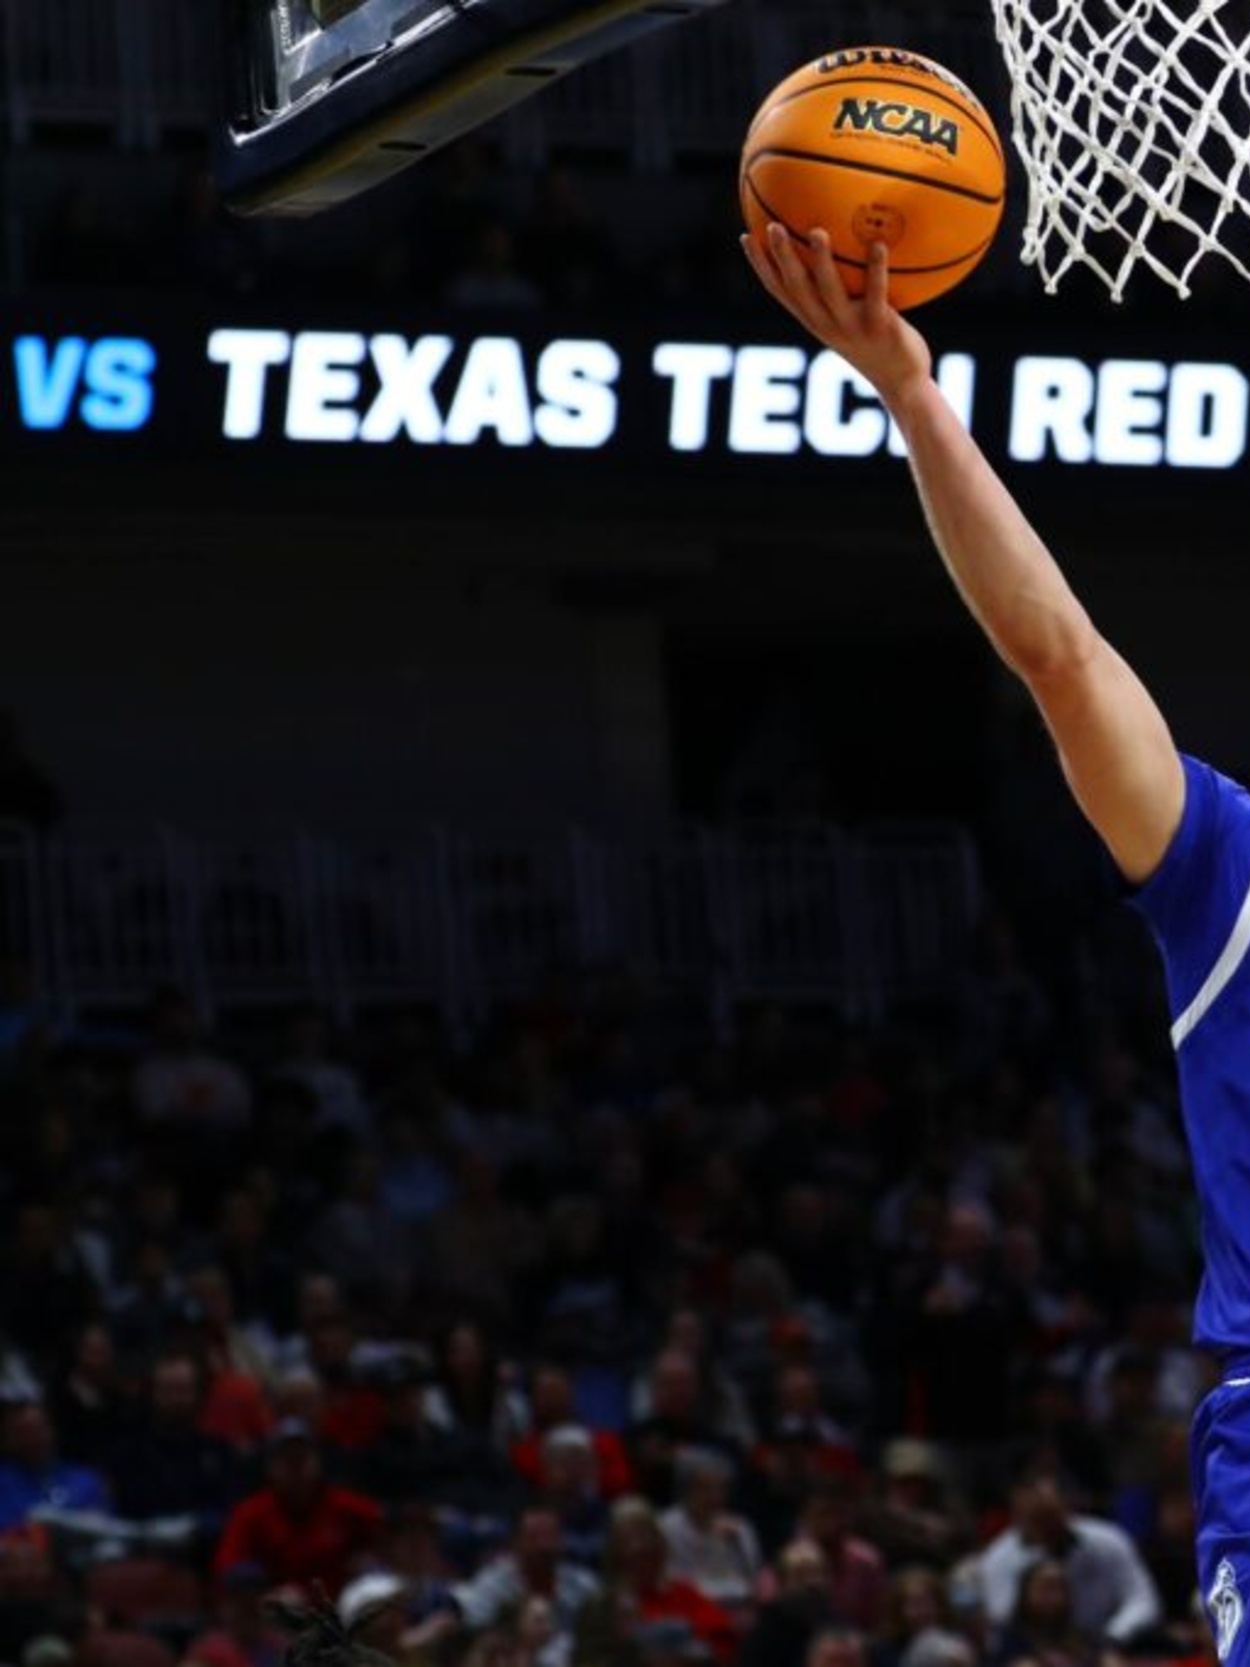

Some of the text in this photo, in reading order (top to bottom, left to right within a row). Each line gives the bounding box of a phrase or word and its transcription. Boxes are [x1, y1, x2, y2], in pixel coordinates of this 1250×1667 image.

[833, 97, 959, 156] NCAA
[13, 334, 157, 431] VS
[206, 328, 621, 448] TEXAS
[1008, 355, 1249, 469] RED
